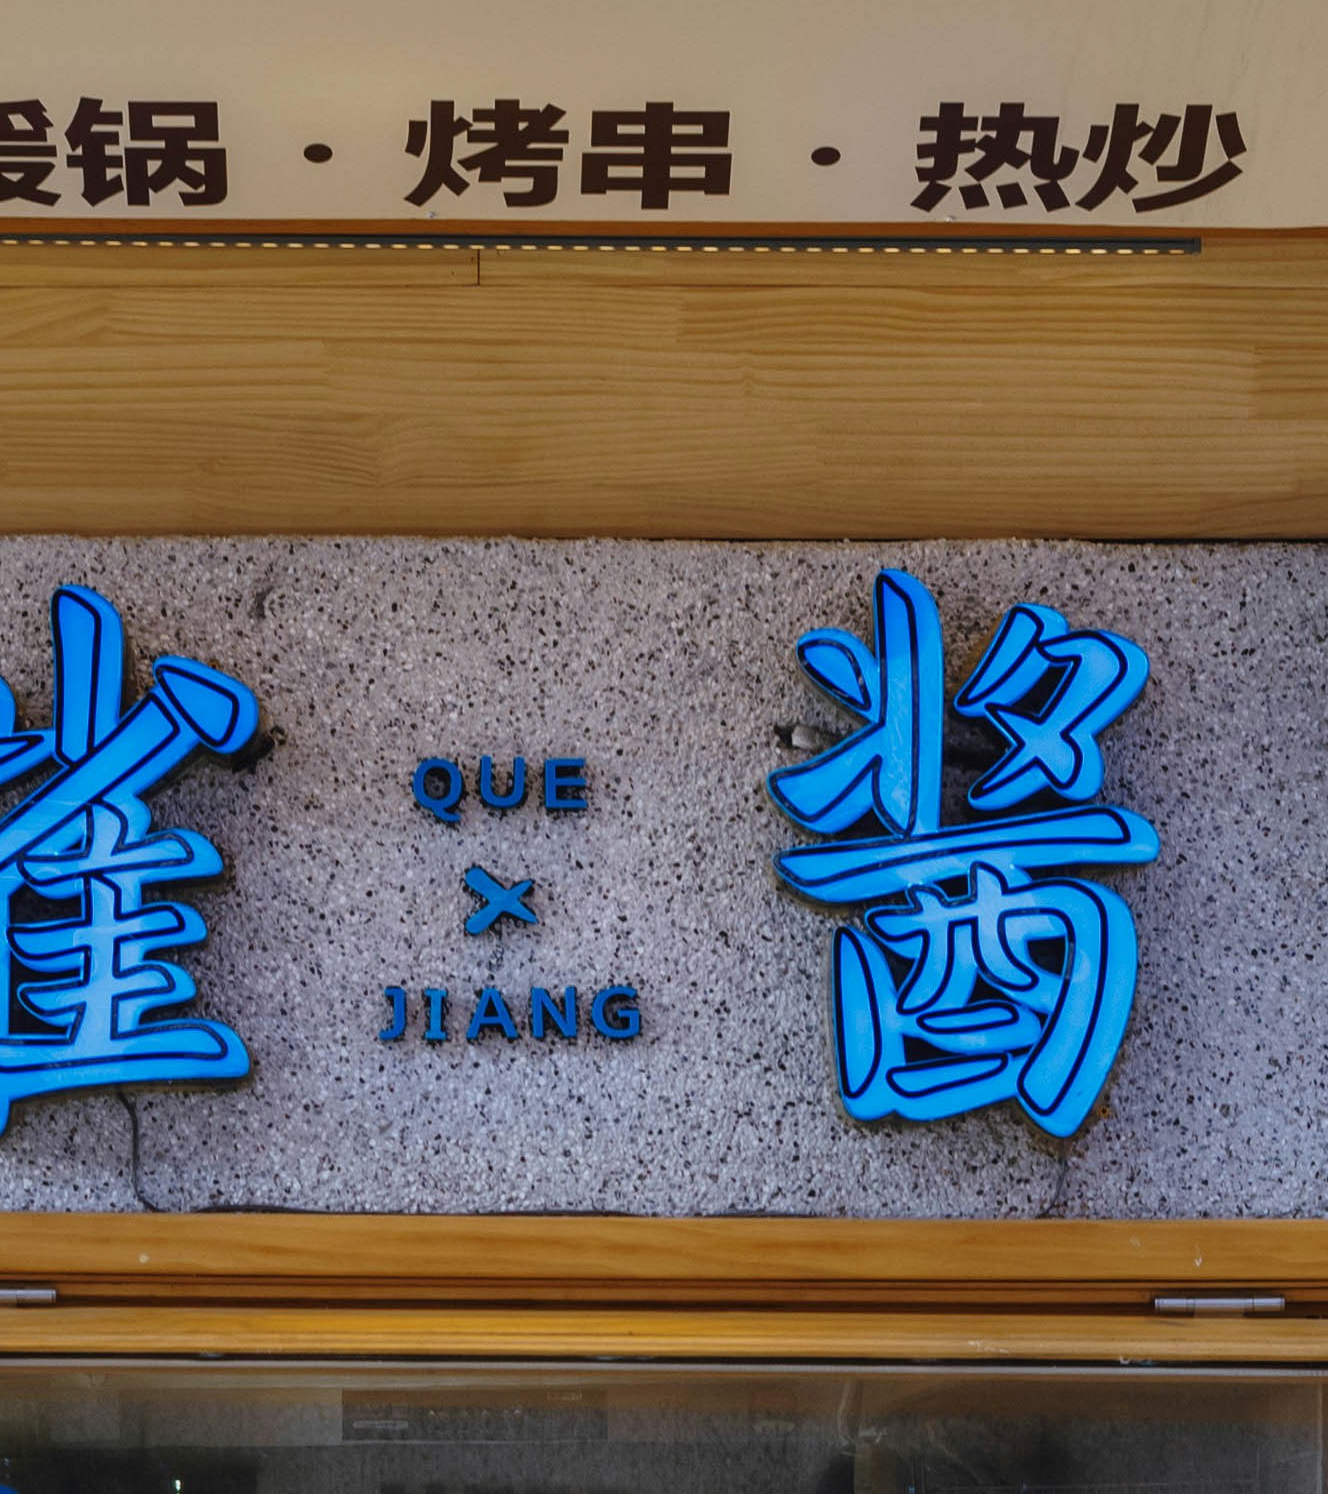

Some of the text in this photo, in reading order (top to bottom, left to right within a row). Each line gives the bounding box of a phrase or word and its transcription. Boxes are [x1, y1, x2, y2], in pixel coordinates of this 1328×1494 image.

[403, 98, 733, 211] 烤串
[909, 101, 1249, 214] 热炒
[412, 754, 589, 823] QUE
[766, 567, 1161, 1138] 酱
[379, 985, 642, 1041] JIANG
